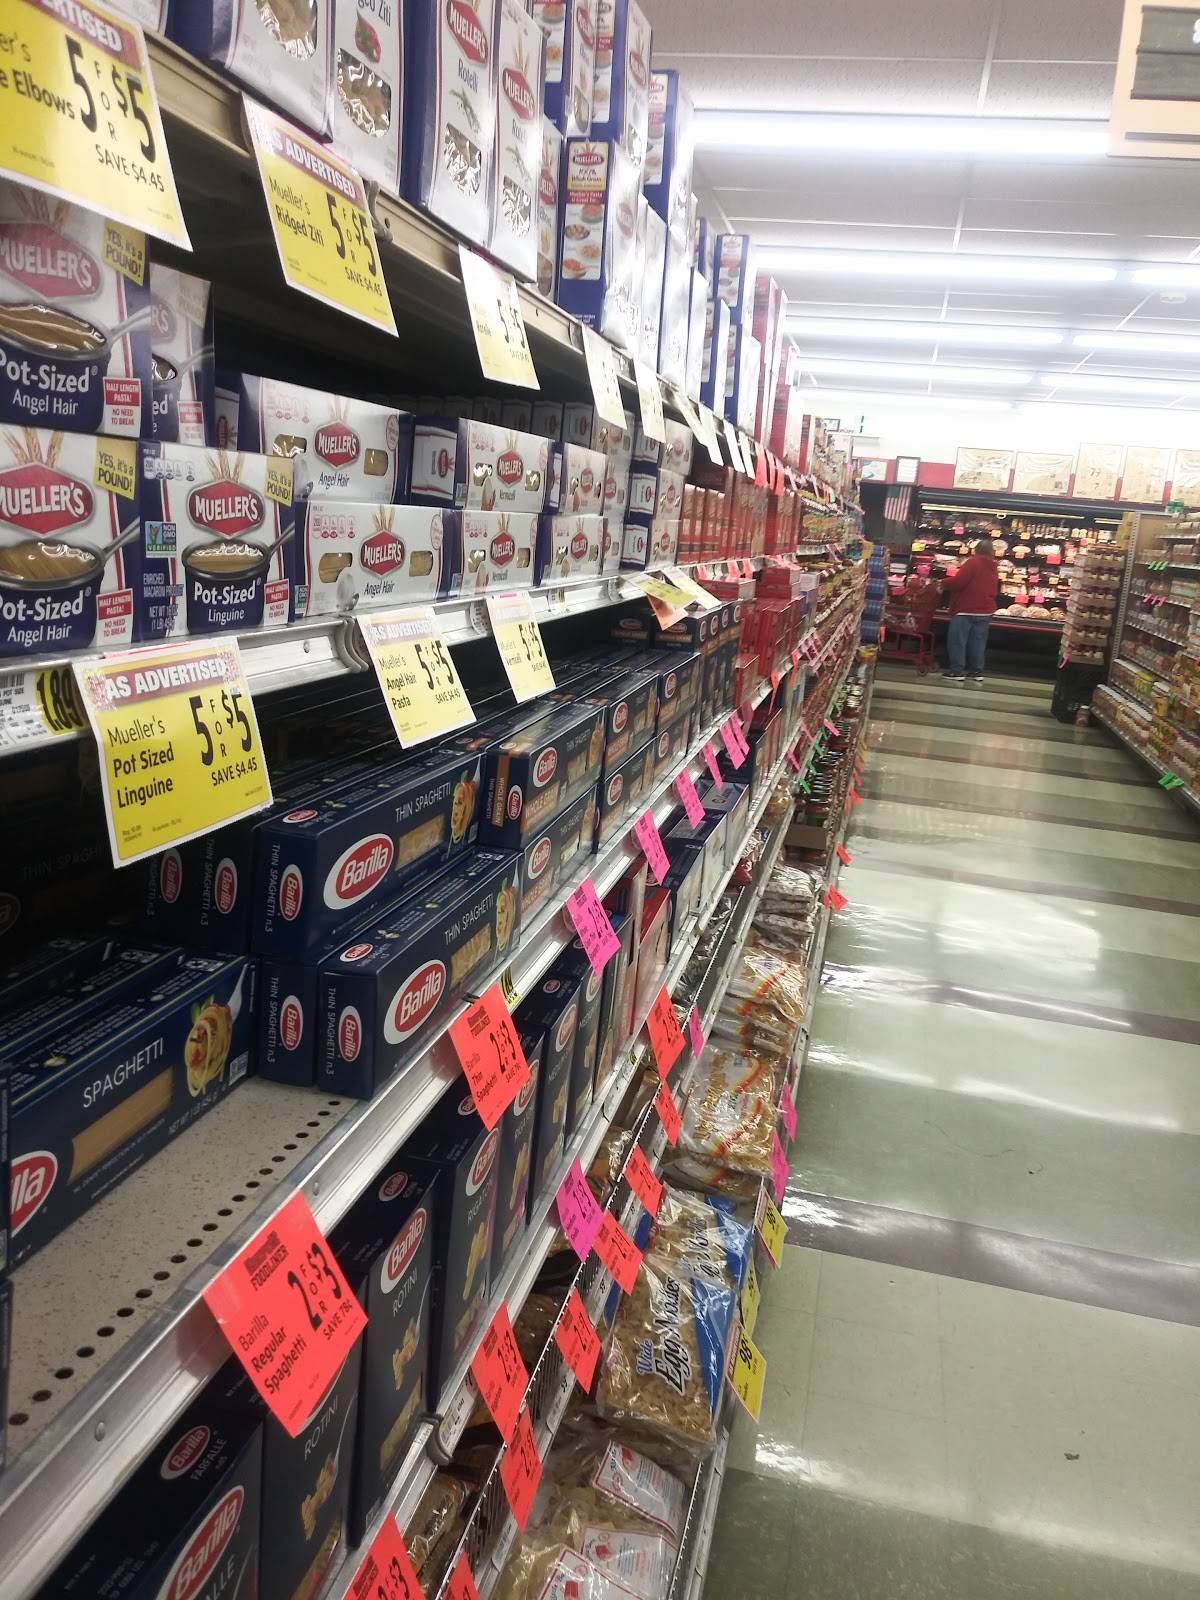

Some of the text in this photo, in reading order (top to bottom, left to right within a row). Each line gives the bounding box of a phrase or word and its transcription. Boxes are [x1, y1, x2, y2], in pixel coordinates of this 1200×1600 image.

[12, 69, 75, 120] Elbows
[66, 35, 97, 133] 5
[112, 64, 156, 163] $5
[95, 144, 165, 192] SAVE $4.45
[286, 135, 357, 201] ADVERTISED
[275, 204, 325, 246] Ridged Ziti
[326, 192, 346, 260] 5
[351, 208, 377, 278] $5
[105, 244, 142, 278] POUND!
[345, 266, 362, 287] SAVE
[497, 299, 510, 344] 5
[13, 388, 79, 416] Angel Hair
[120, 408, 134, 418] NEED
[120, 417, 135, 427] BREAK
[98, 450, 116, 470] YES,
[318, 433, 357, 455] MUELLER'S
[98, 465, 134, 492] POUND!
[266, 480, 291, 501] POUND!
[318, 472, 350, 491] Angel Hair
[163, 523, 176, 532] NON
[195, 493, 259, 523] MUELLER'S
[147, 545, 176, 553] VERIFIED
[163, 531, 176, 539] GMO
[363, 542, 402, 566] MUELLER'S
[194, 580, 256, 606] Pot-Sized
[364, 582, 394, 598] Angel Hair
[8, 623, 72, 647] Angel Hair
[112, 626, 127, 638] BREAK
[113, 618, 126, 630] NEED
[208, 608, 245, 626] Linguine
[519, 624, 531, 661] 5
[105, 658, 227, 700] AS ADVERTISED
[386, 673, 417, 692] Angel Hair
[415, 640, 454, 690] 5 $5
[37, 669, 83, 731] 1.89
[392, 695, 412, 710] Pasta
[435, 692, 448, 705] SAVE
[108, 716, 166, 748] Mueller's
[189, 695, 214, 766] 5
[221, 690, 252, 753] $5
[113, 741, 174, 778] Pot Sized
[212, 757, 258, 787] SAVE $4.45
[117, 777, 174, 809] Linguine
[395, 782, 452, 822] THIN SPAGHETTI
[272, 844, 281, 867] THIN
[340, 844, 391, 893] Barilla
[219, 869, 233, 911] Barilla
[267, 869, 280, 918] SPAGHETTI
[285, 876, 299, 918] Barilla
[444, 893, 494, 946] THIN SPAGHETTI
[271, 976, 280, 993] THIN
[327, 986, 337, 1010] THIN
[399, 972, 443, 1028] Barilla
[267, 995, 279, 1047] SPAGHETTI
[285, 1010, 299, 1050] Barilla
[325, 1011, 337, 1059] SPAGHETTI
[345, 1018, 357, 1060] Barilla
[83, 1038, 165, 1108] SPAGHETTI
[490, 1033, 505, 1074] 2
[476, 1073, 498, 1103] Spaghetti
[389, 1215, 423, 1275] Barilla
[250, 1244, 289, 1292] FOODLINER
[287, 1271, 323, 1332] 2
[306, 1242, 342, 1300] $3
[392, 1268, 419, 1317] ROTINI
[238, 1313, 269, 1352] Barilla
[250, 1326, 287, 1373] Regular
[322, 1319, 343, 1342] SAVE
[654, 1275, 691, 1396] Egg Noodles
[264, 1334, 308, 1395] Spaghetti
[637, 1338, 654, 1375] Wide
[304, 1395, 339, 1461] ROTINI
[170, 1428, 207, 1470] Barilla
[190, 1438, 227, 1482] FARFALLE
[173, 1498, 239, 1600] Barilla
